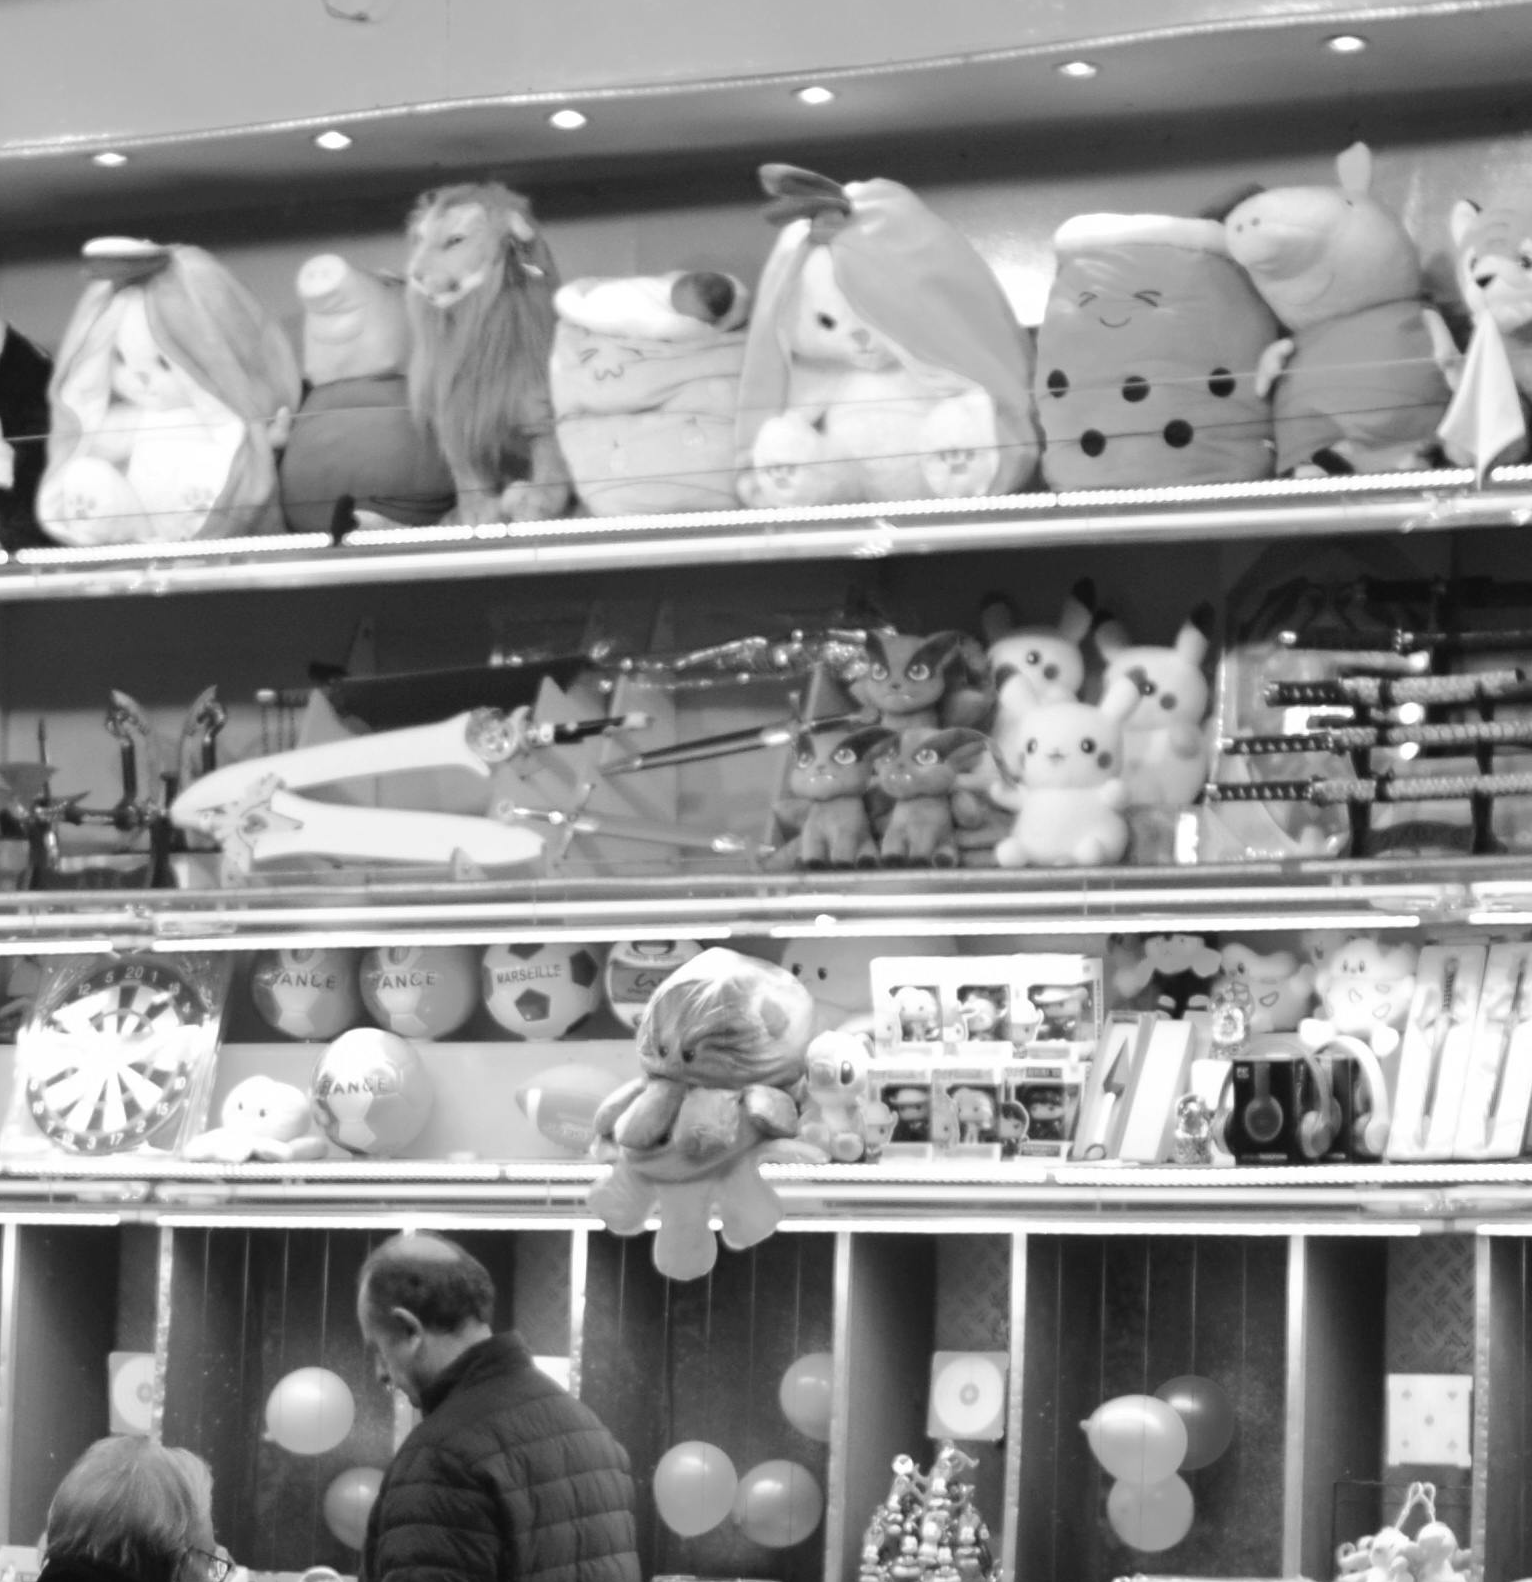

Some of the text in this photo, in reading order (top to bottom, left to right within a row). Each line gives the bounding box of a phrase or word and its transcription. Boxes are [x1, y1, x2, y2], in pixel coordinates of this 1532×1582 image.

[105, 970, 115, 984] 5
[125, 965, 145, 979] 20
[496, 963, 562, 984] MARSEILLE
[78, 983, 92, 996] 12
